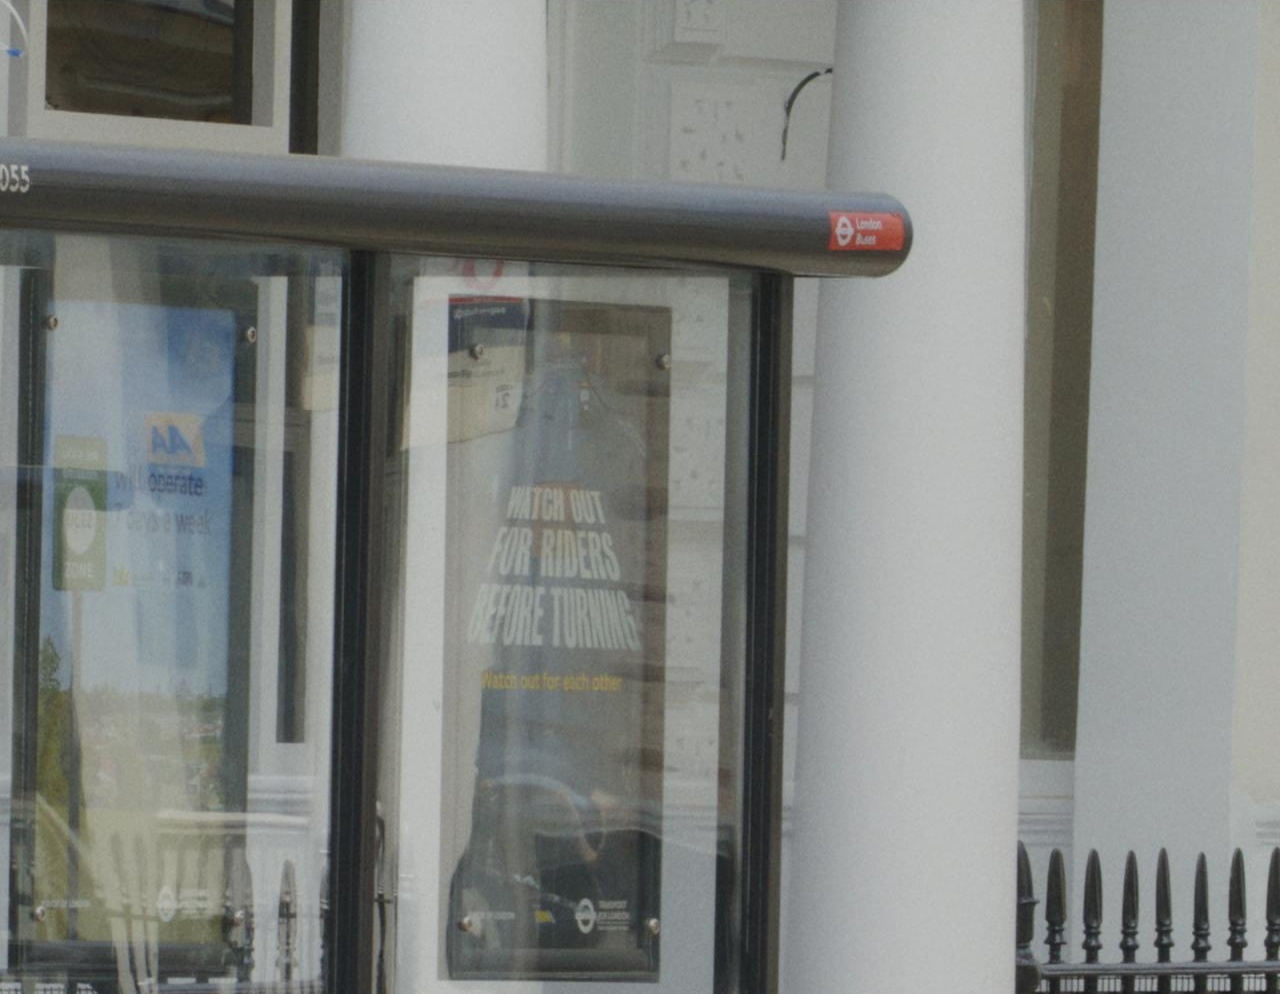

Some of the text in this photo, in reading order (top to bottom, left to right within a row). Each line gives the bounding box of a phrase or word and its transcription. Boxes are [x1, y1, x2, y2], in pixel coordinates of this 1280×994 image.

[855, 218, 883, 230] London
[855, 232, 877, 245] Buses
[148, 473, 205, 501] operate
[507, 486, 606, 525] WATCH OUT
[488, 526, 621, 582] FOR RIDERS
[468, 583, 642, 651] BEFORE TURNING
[481, 670, 623, 692] Watch out for each other
